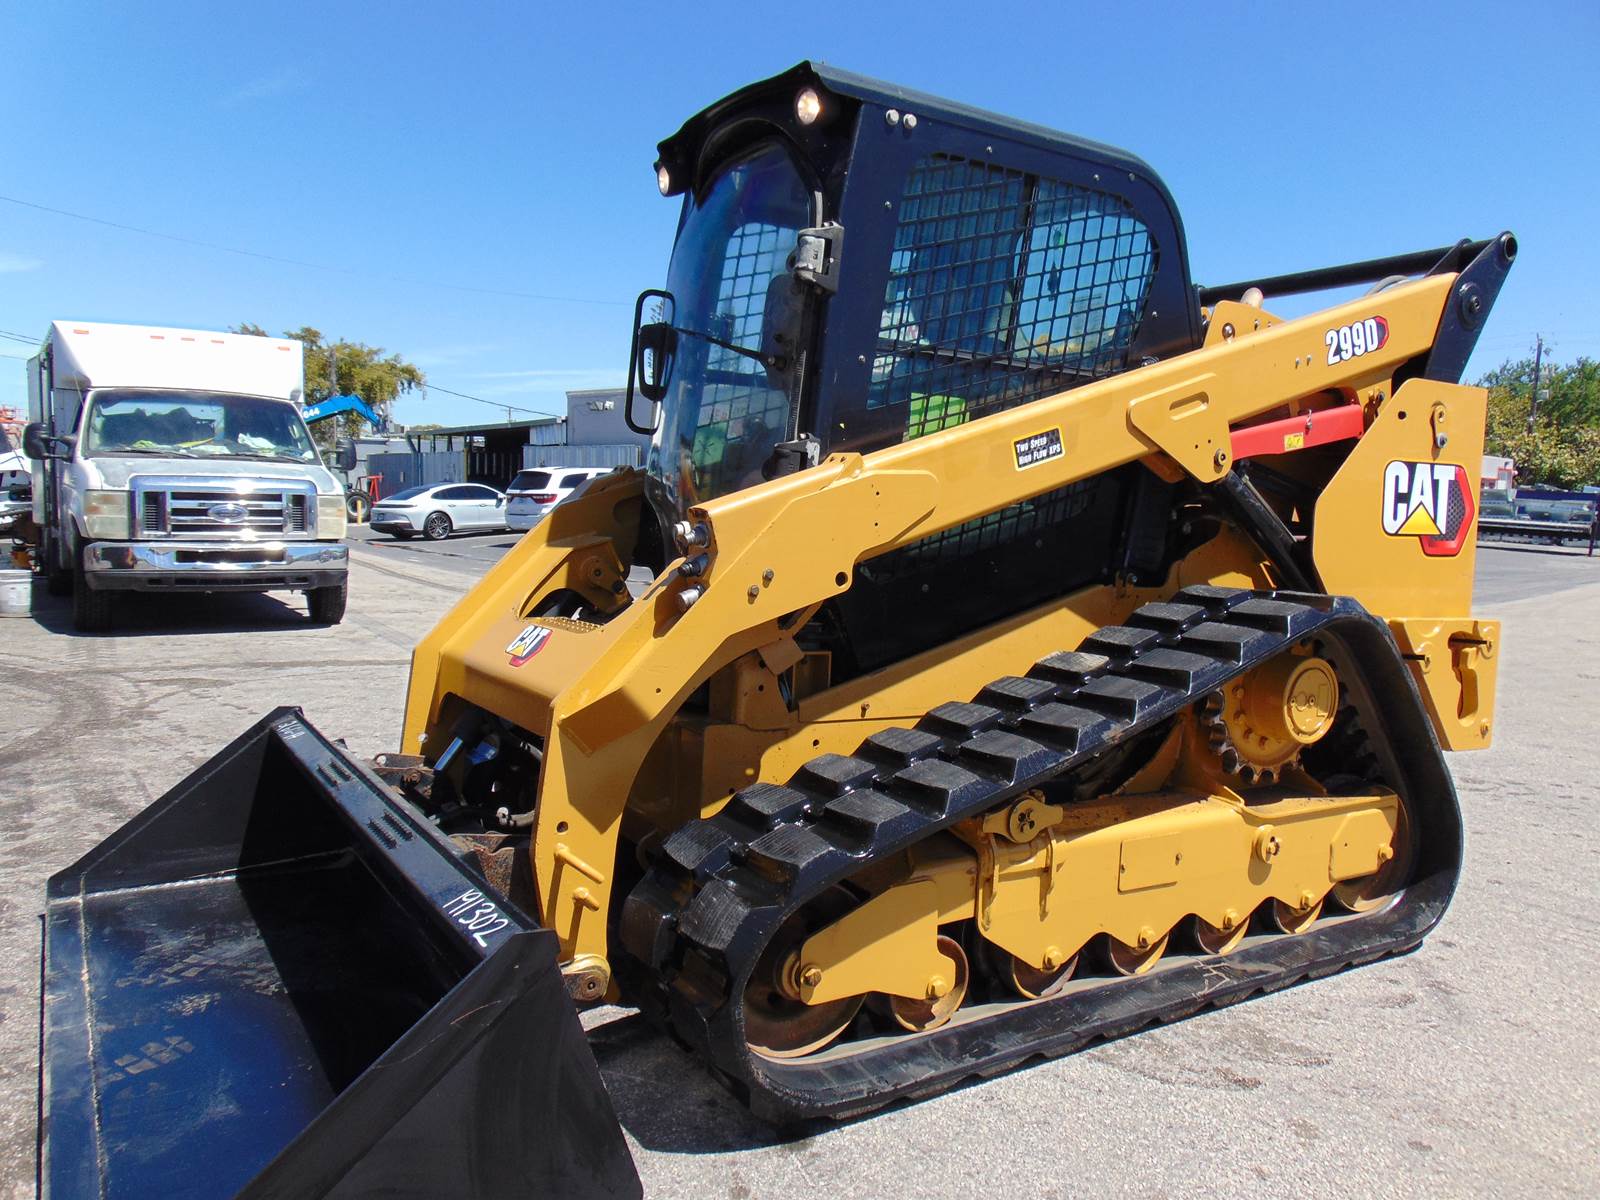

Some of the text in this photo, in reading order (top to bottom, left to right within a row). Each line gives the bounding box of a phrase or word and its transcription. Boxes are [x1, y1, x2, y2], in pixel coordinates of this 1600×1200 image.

[1325, 318, 1379, 365] 299D
[1383, 460, 1456, 535] CAT
[505, 624, 552, 657] CAT
[442, 888, 508, 948] 191302
